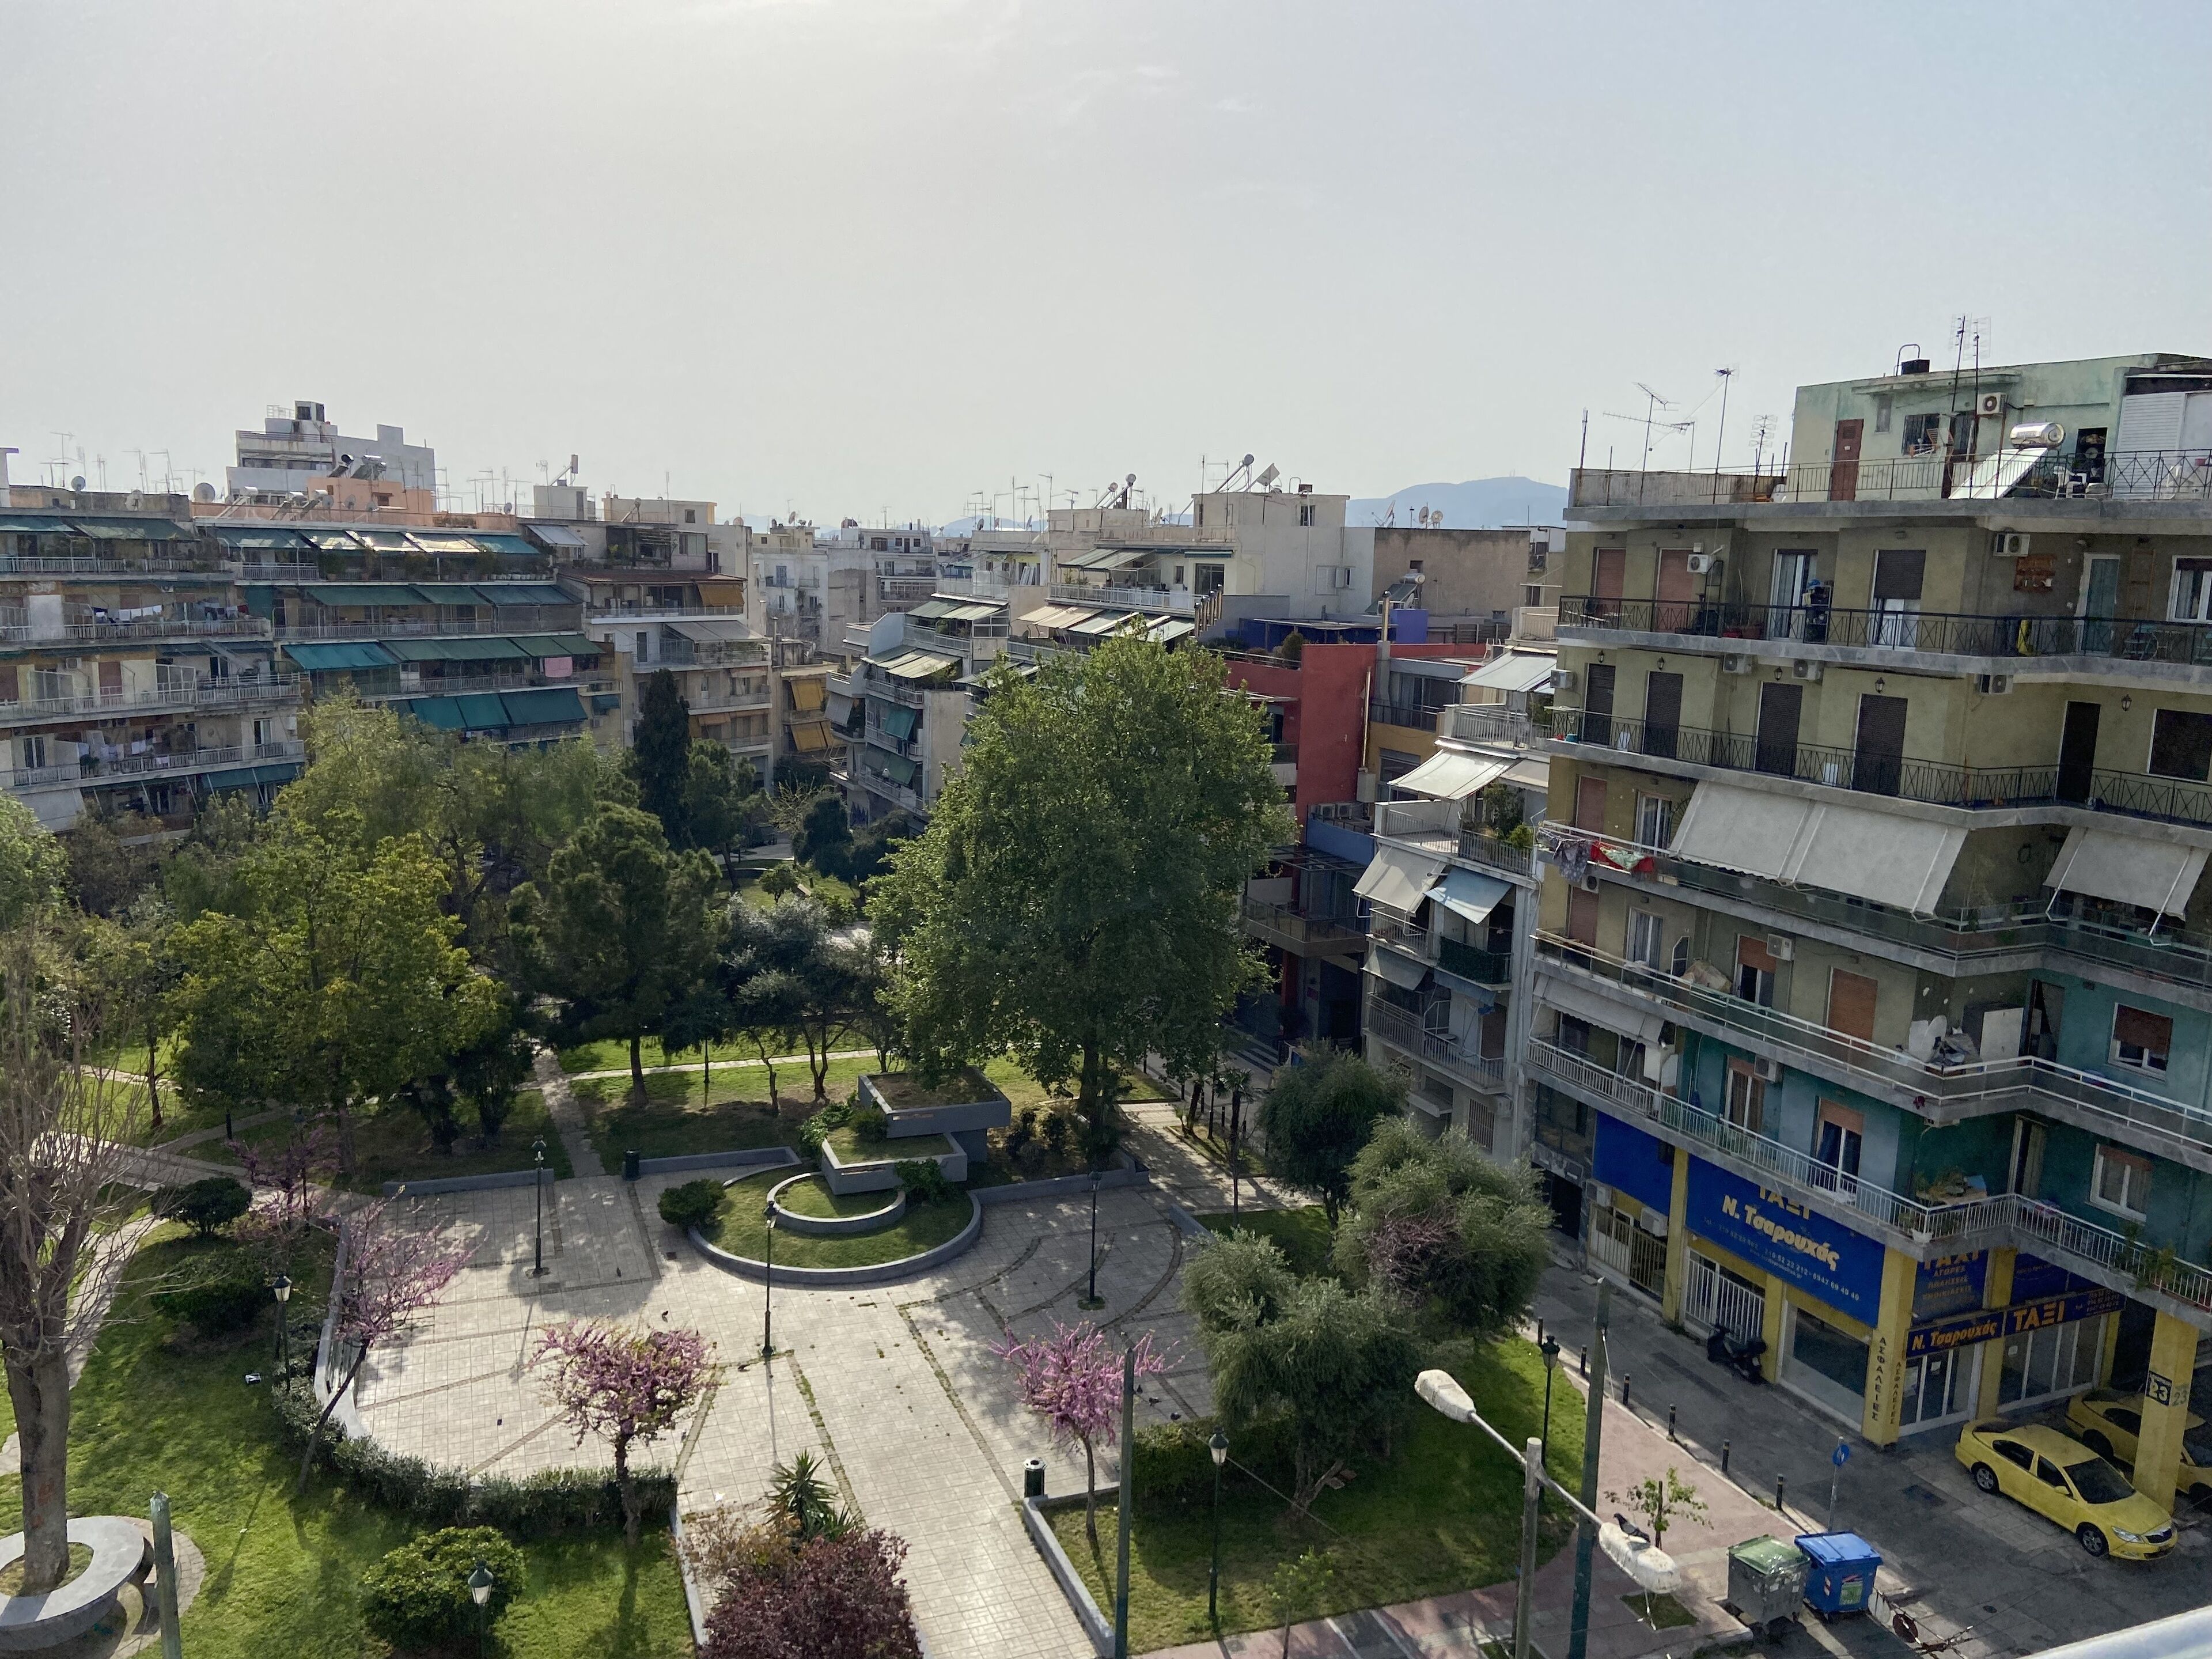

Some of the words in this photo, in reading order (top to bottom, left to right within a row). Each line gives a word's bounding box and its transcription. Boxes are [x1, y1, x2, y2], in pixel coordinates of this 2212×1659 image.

[1744, 1204, 1840, 1272] Τσαρουχάς
[1930, 1320, 1997, 1347] Τσαρουχάς
[2013, 1300, 2065, 1331] ΤΑΞΙ
[1872, 1336, 1887, 1421] ΑΣΦΑΛΕΙΕΣ
[1890, 1362, 1902, 1425] ΑΣΦΑΛΕΙΕΣ
